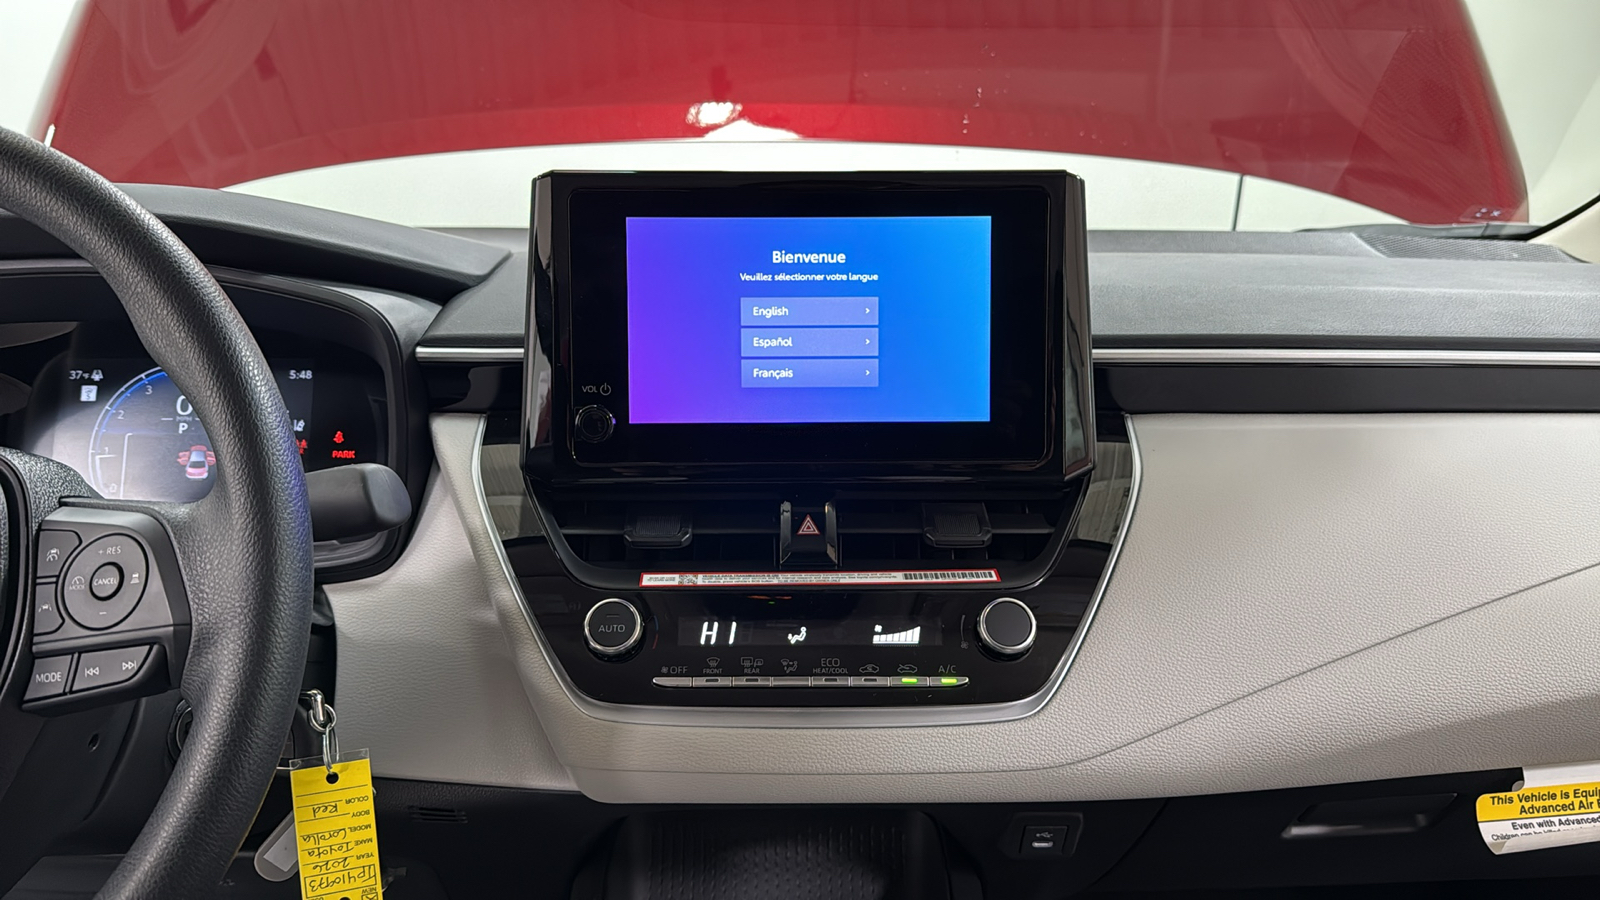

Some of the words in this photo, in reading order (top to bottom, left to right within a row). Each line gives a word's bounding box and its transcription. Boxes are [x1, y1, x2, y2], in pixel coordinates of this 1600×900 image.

[772, 250, 846, 264] Bienvenue
[740, 272, 772, 282] Veuillez
[774, 272, 825, 282] sélectionner
[826, 273, 848, 282] votre
[848, 272, 879, 283] langue
[752, 306, 789, 318] English
[752, 337, 793, 349] Español
[289, 370, 313, 380] 5:48
[752, 368, 794, 380] Français
[145, 384, 153, 395] 3
[581, 385, 598, 393] VOL
[118, 410, 124, 420] 2
[178, 422, 188, 434] P
[332, 450, 356, 458] PARK
[106, 546, 122, 555] RES
[94, 578, 118, 586] CANCEL
[598, 624, 626, 633] AUTO
[700, 621, 737, 645] HI
[820, 658, 840, 667] ECO
[670, 666, 688, 674] OFF
[938, 664, 957, 674] A/C
[36, 672, 62, 684] MODE
[345, 795, 369, 804] COLOR
[1490, 795, 1514, 806] This
[1518, 791, 1558, 803] Vehicle
[1560, 790, 1570, 800] is
[1574, 787, 1600, 801] Equi
[312, 803, 338, 818] Red
[1520, 802, 1576, 815] Advanced
[1578, 800, 1594, 810] Air
[351, 809, 370, 818] BODY
[348, 823, 372, 832] MODEL
[1511, 822, 1535, 831] Even
[1536, 819, 1557, 829] with
[302, 828, 347, 846] Corolla
[354, 838, 373, 846] MAKE
[307, 842, 354, 858] Toyota
[356, 852, 374, 860] YEAR
[312, 857, 350, 873] 2026
